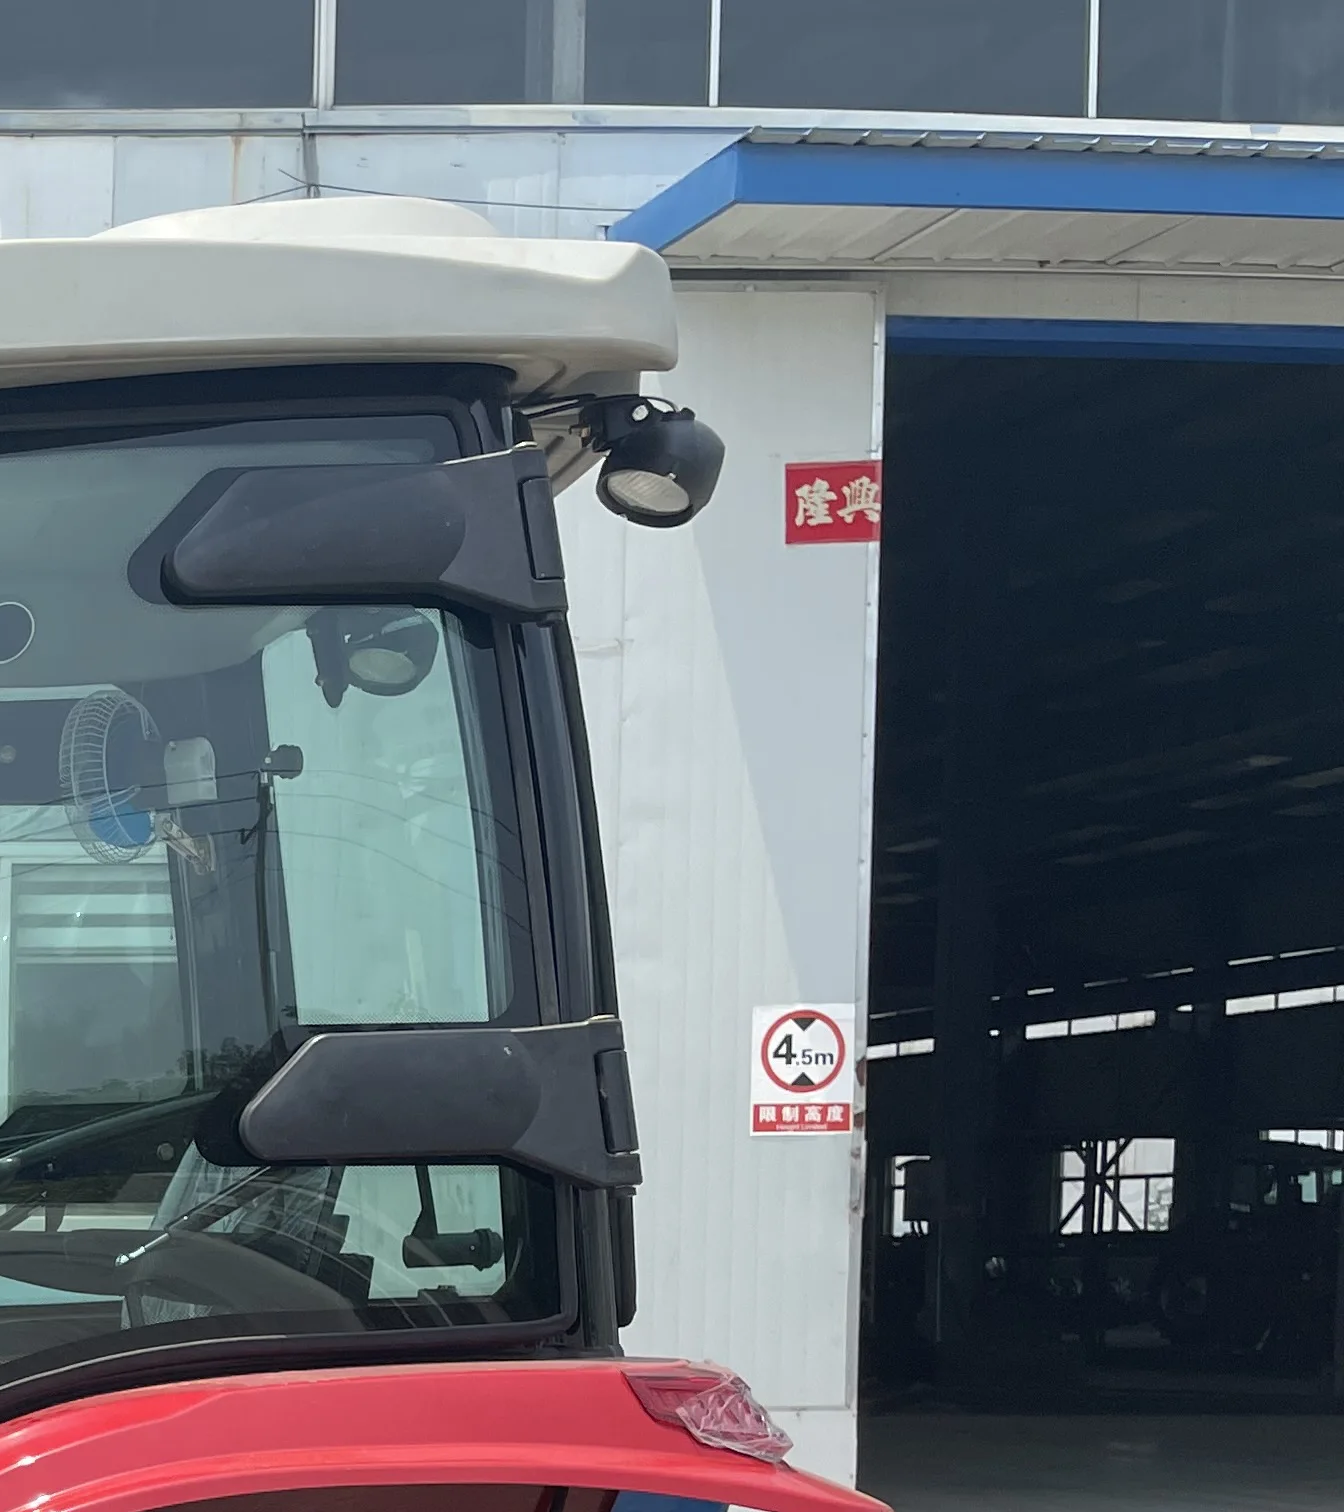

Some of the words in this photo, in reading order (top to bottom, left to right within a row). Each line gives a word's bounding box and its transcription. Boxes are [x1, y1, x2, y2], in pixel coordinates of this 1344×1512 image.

[772, 1033, 835, 1066] 4.5m
[759, 1105, 844, 1123] 限制高度
